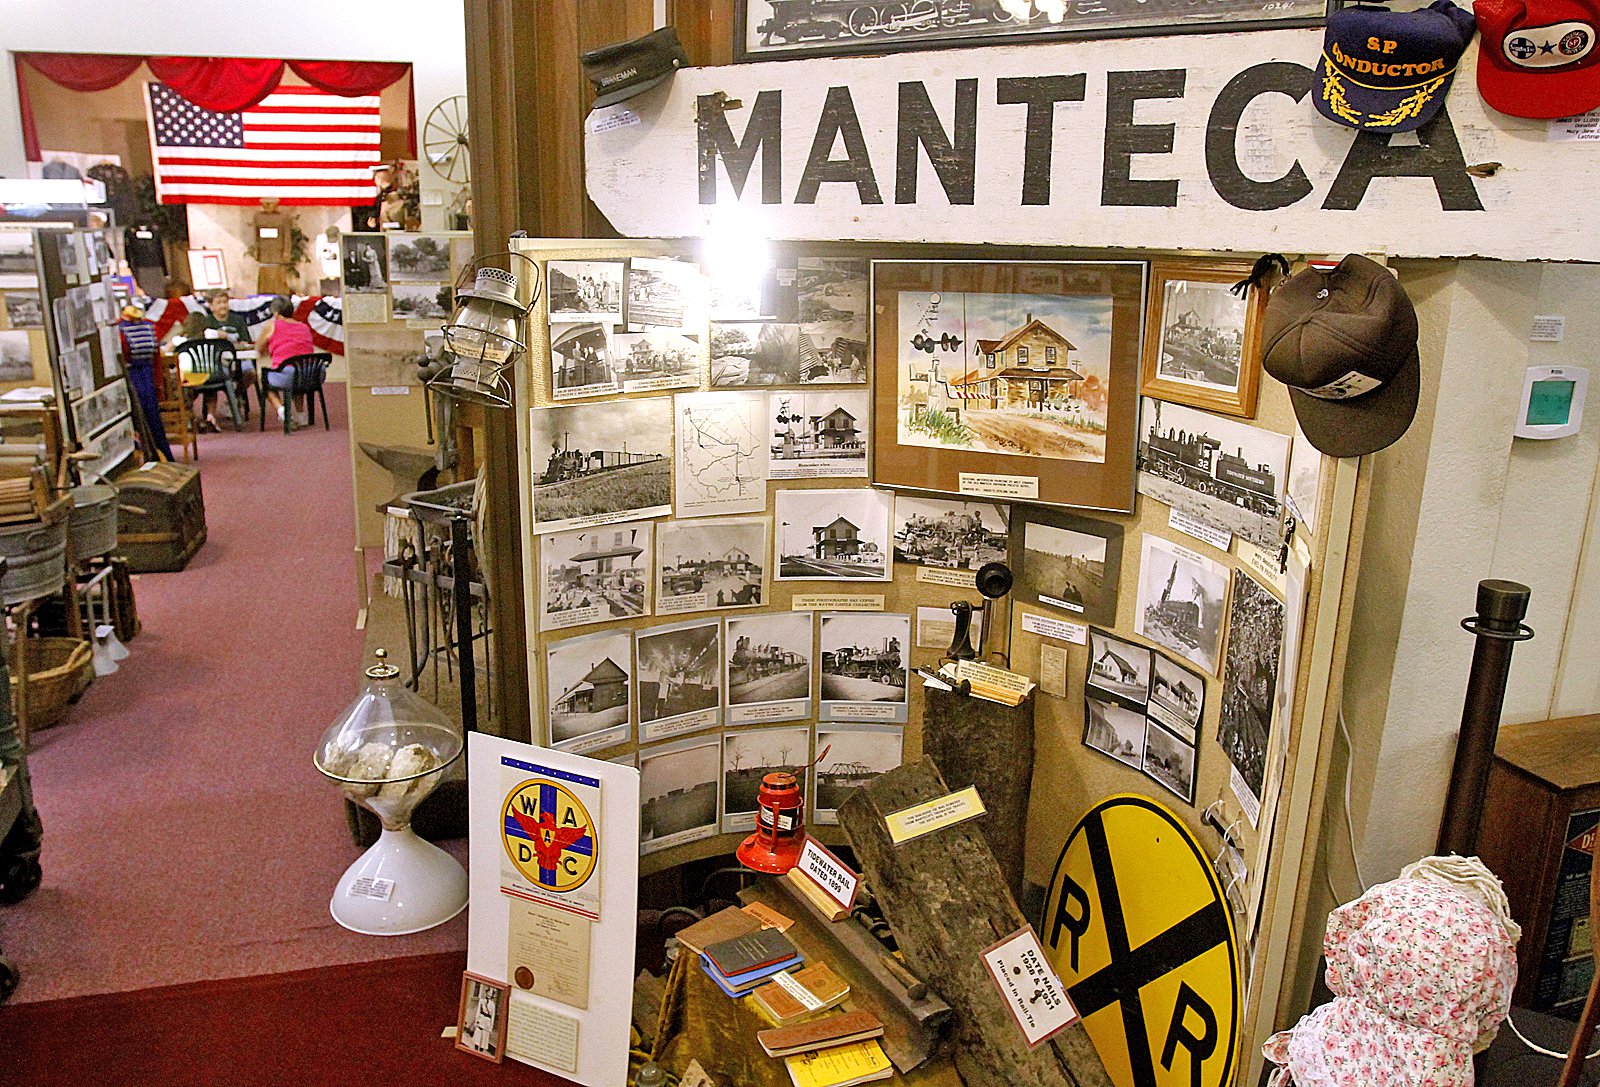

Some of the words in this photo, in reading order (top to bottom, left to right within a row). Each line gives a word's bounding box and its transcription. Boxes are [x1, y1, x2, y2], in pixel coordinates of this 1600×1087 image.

[1332, 41, 1445, 77] CONDUCTOR
[696, 61, 1486, 213] MANTECA
[1198, 458, 1209, 470] 32
[520, 794, 538, 816] W
[563, 806, 578, 828] A
[544, 830, 551, 844] A
[518, 843, 532, 862] D
[563, 856, 578, 876] C
[807, 848, 838, 879] TIDEWATER
[837, 872, 850, 890] RAIL
[809, 862, 828, 882] DATED
[828, 876, 842, 894] 1899
[1050, 873, 1090, 975] R
[997, 959, 1014, 988] Placed
[1012, 988, 1019, 997] in
[1017, 998, 1036, 1028] Rail-Tie
[1020, 952, 1036, 976] 1928
[1033, 978, 1041, 986] &
[1040, 988, 1055, 1011] 1931
[1026, 949, 1045, 976] DATE
[1042, 976, 1061, 1006] NAILS
[1160, 980, 1218, 1087] R
